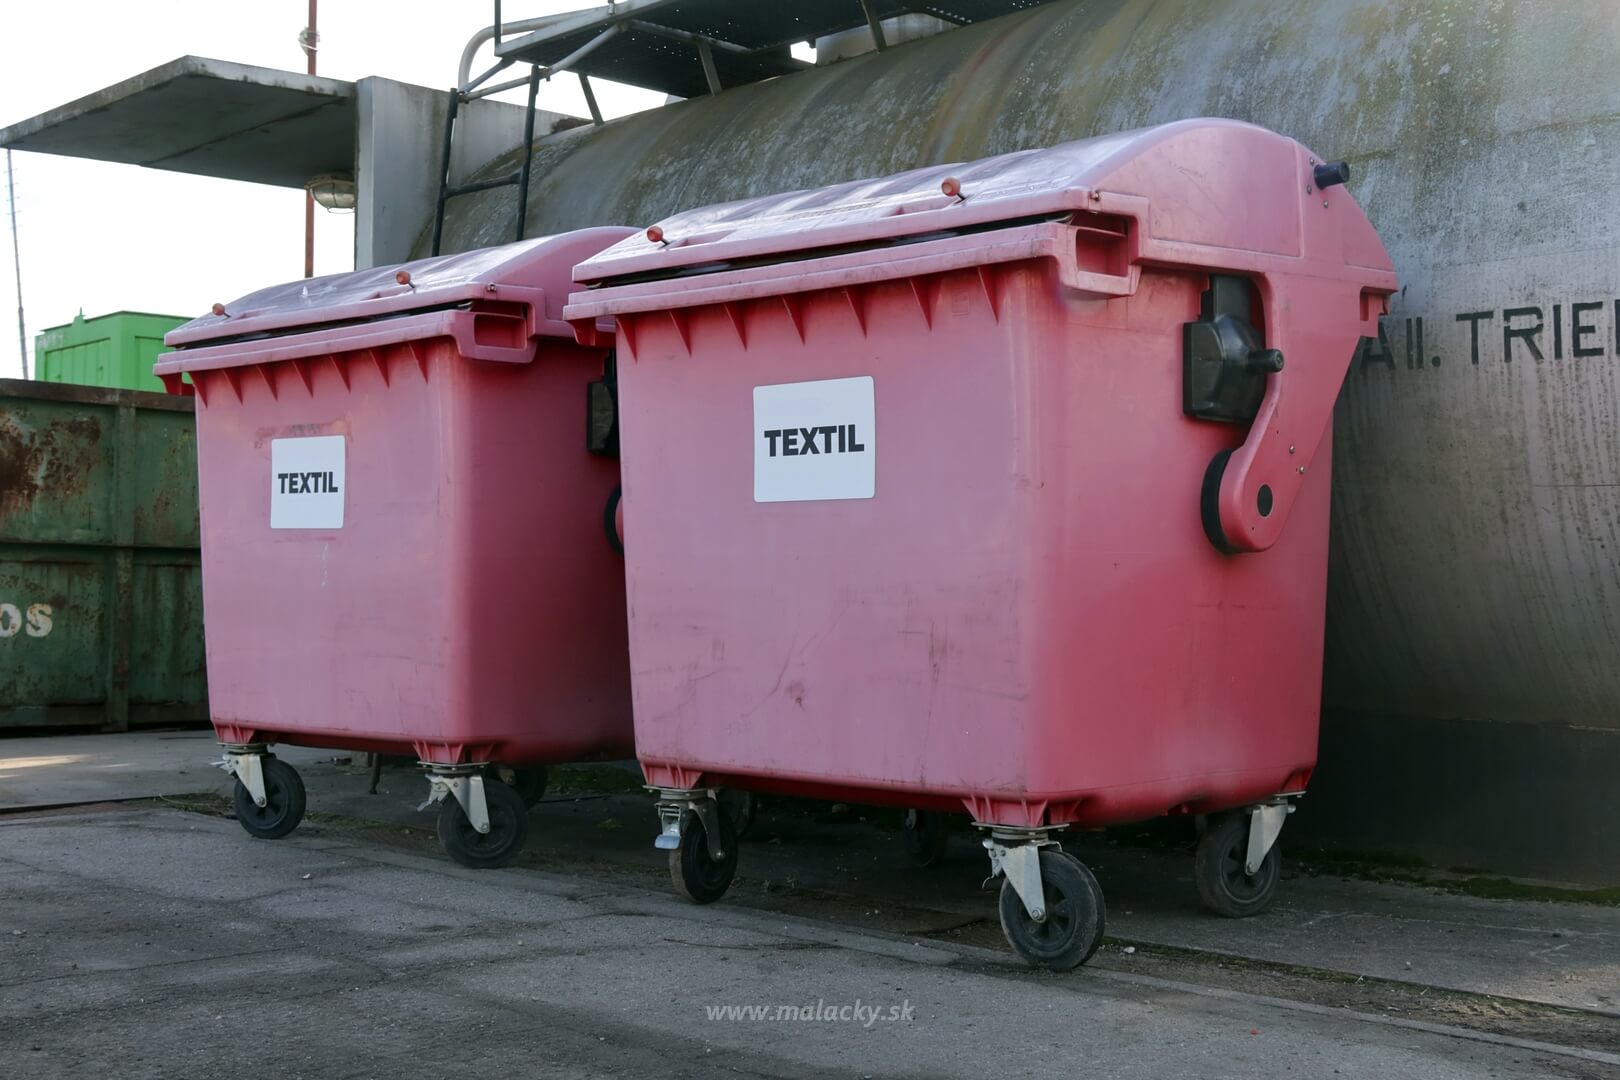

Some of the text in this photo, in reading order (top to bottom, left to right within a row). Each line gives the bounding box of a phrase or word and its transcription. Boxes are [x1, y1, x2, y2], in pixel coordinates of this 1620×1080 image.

[1455, 299, 1620, 365] TRIE
[764, 424, 865, 457] TEXTIL
[278, 471, 338, 494] TEXTIL
